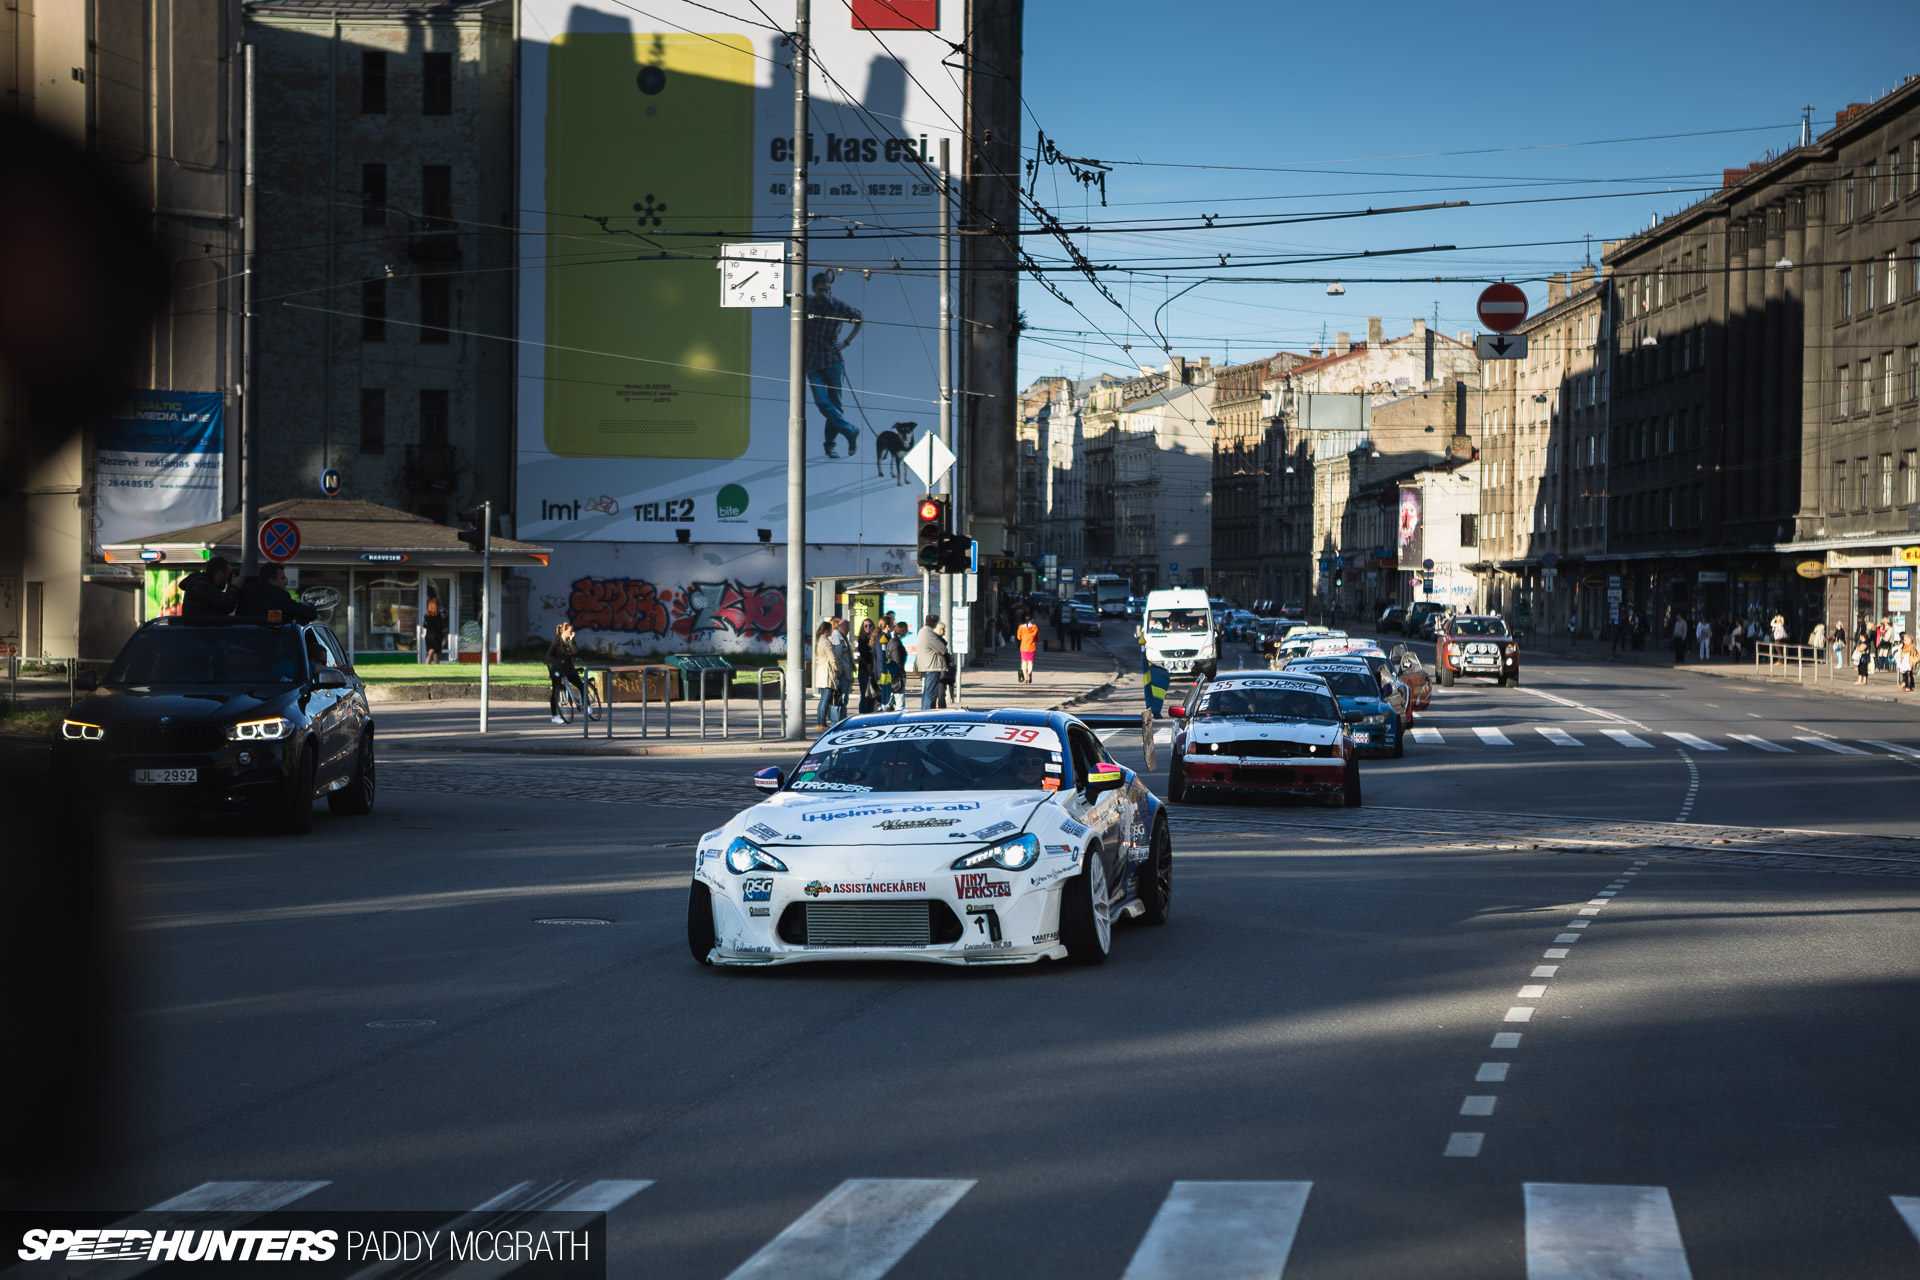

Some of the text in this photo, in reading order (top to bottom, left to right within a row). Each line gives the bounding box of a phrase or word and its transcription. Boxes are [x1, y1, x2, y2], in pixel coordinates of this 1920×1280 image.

[827, 133, 878, 163] kas
[885, 134, 934, 163] esi.
[770, 183, 786, 195] 4G
[739, 292, 744, 300] 7
[135, 411, 211, 423] MEDIA LINE
[100, 456, 139, 467] Rezervē
[145, 458, 190, 468] reklāmas
[325, 475, 337, 488] N
[634, 498, 695, 522] TELE2
[719, 507, 741, 517] bite
[1213, 680, 1325, 690] 55 DRIFT
[885, 724, 1040, 743] DRIFT 39
[902, 805, 936, 813] rör
[943, 802, 973, 811] ab
[833, 880, 926, 893] ASSISTANCEKÅREN
[953, 873, 988, 892] VINYL
